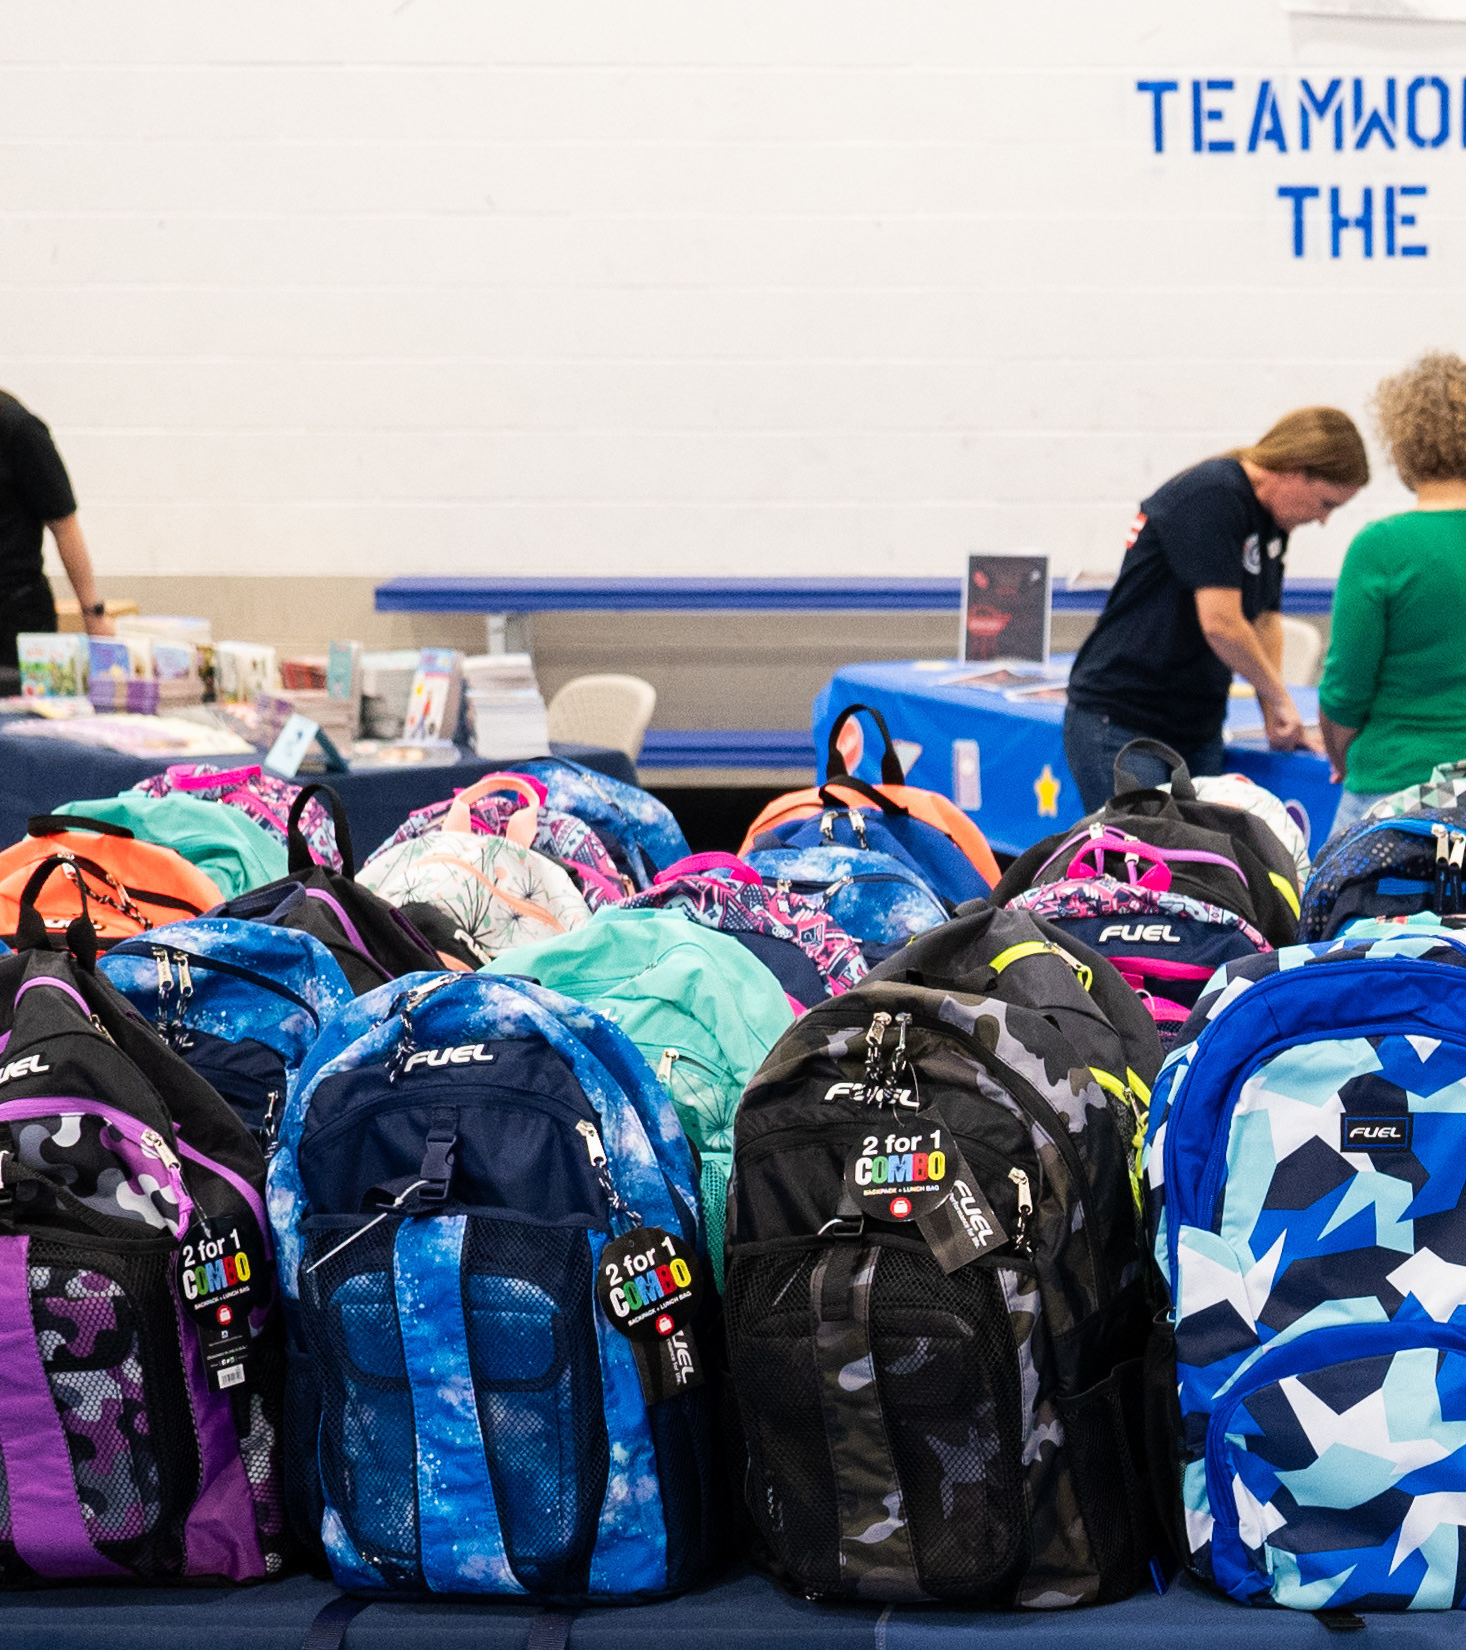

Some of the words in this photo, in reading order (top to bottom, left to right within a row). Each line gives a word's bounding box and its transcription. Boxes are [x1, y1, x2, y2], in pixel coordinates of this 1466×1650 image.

[1276, 185, 1430, 260] THE
[1096, 924, 1178, 942] FUEL
[402, 1044, 492, 1073] FUEL
[863, 1136, 879, 1156] 2
[885, 1133, 922, 1153] for
[930, 1129, 941, 1149] 1
[1348, 1126, 1401, 1139] FUEL
[854, 1151, 946, 1186] COMBO
[954, 1180, 994, 1247] FUEL
[182, 1245, 196, 1267] 2
[198, 1237, 225, 1261] for
[230, 1228, 241, 1249] 1
[605, 1263, 623, 1286] 2
[623, 1247, 656, 1276] for
[661, 1236, 676, 1257] 1
[182, 1252, 251, 1300] COMBO
[609, 1258, 691, 1318] COMBO
[672, 1330, 694, 1384] UEL
